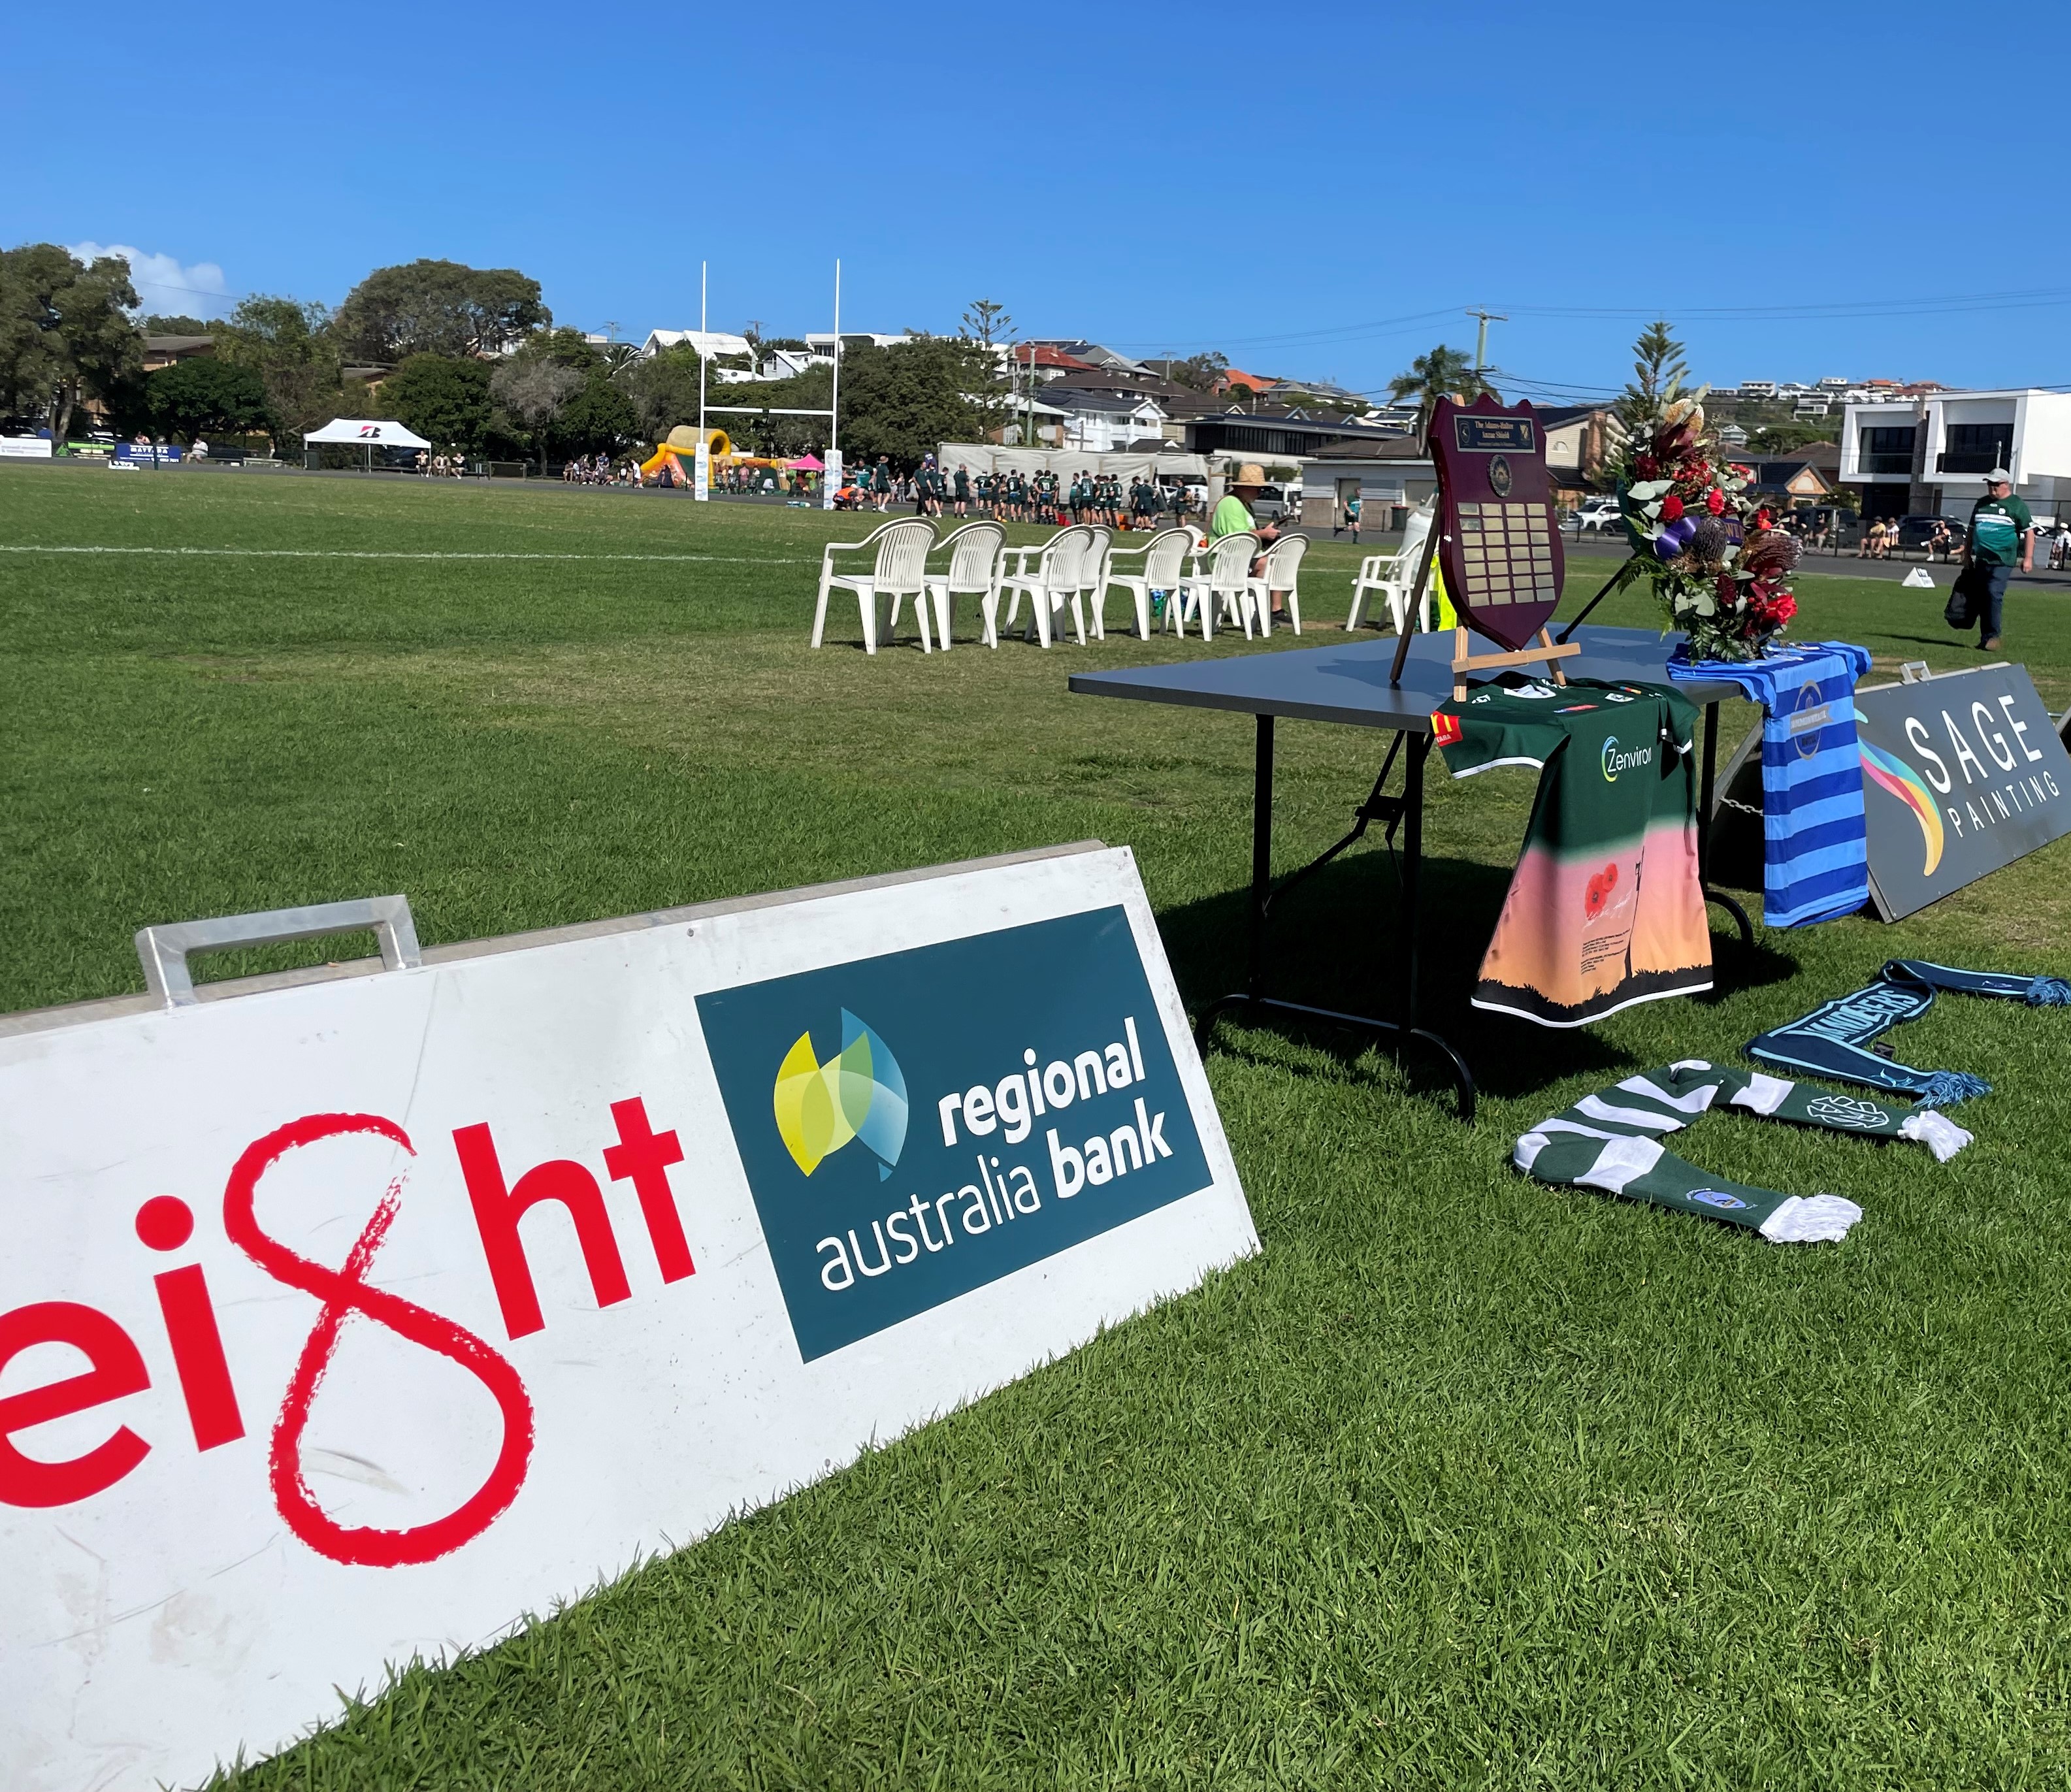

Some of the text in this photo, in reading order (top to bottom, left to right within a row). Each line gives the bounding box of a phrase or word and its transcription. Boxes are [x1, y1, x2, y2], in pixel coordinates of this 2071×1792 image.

[1905, 694, 2043, 794] SAGE
[1947, 771, 2060, 838] PAINTING
[938, 1016, 1146, 1147] regional
[816, 1098, 1173, 1291] australia bank
